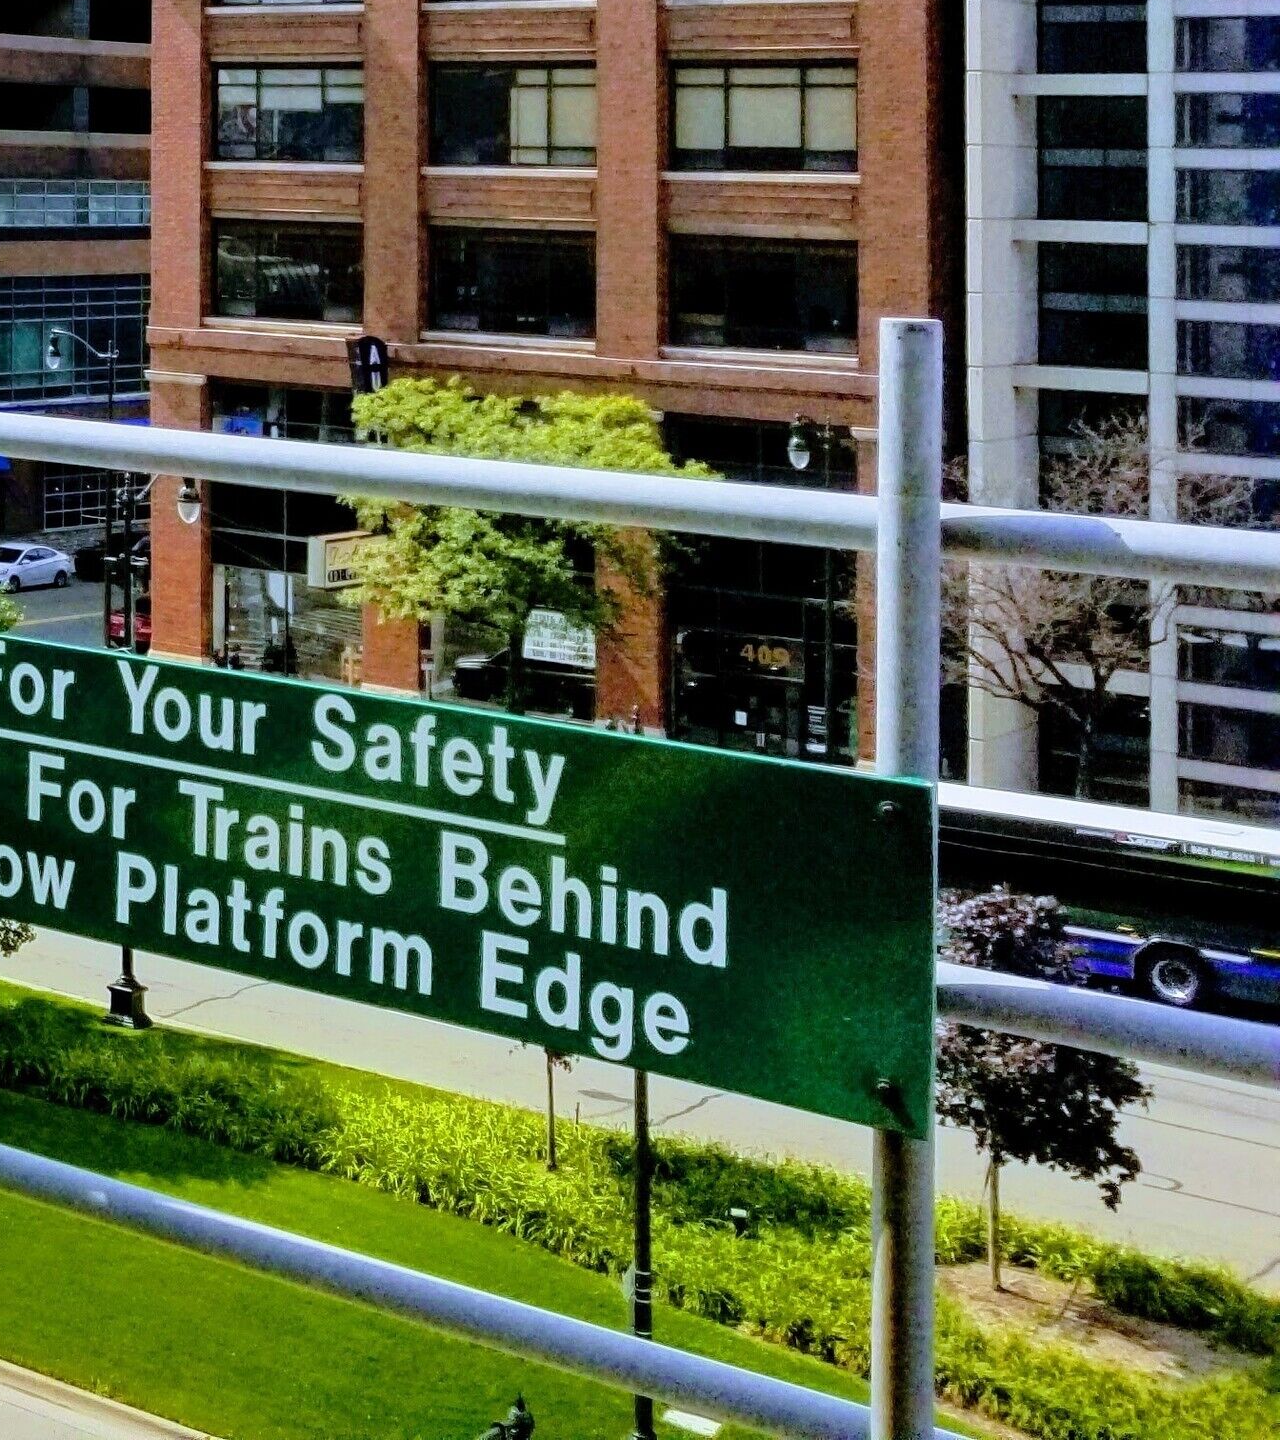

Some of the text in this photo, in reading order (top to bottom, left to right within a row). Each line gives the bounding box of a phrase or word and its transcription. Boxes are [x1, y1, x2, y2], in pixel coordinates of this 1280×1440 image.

[118, 659, 266, 755] Your
[312, 694, 566, 826] Safety
[28, 750, 136, 839] For
[179, 779, 392, 895] Trains
[439, 830, 727, 968] Behind
[116, 851, 433, 996] Platform
[480, 930, 690, 1061] Edge
